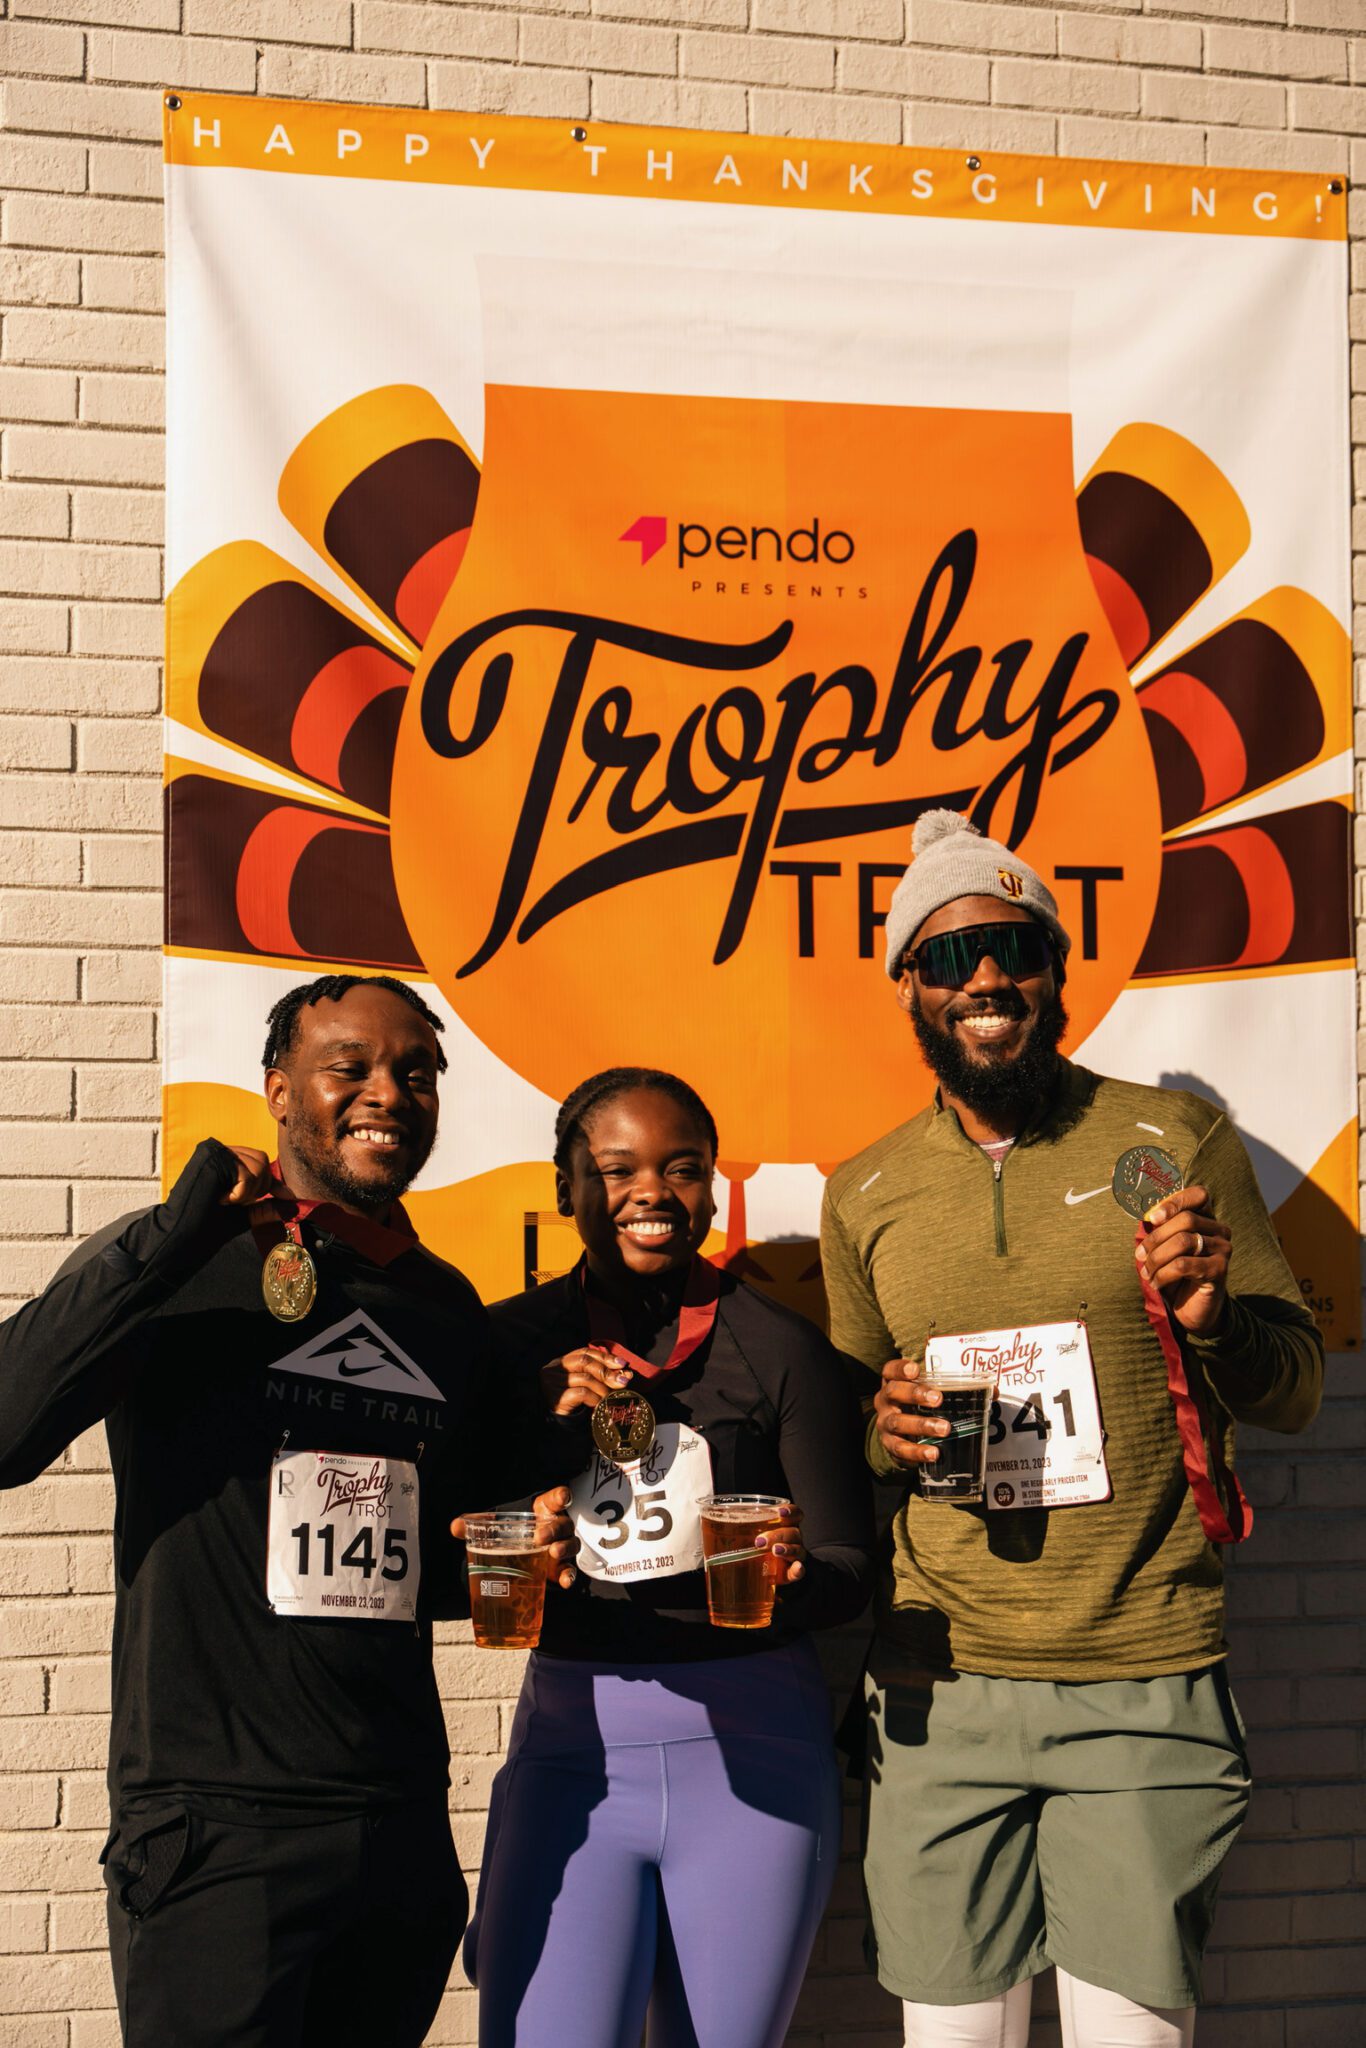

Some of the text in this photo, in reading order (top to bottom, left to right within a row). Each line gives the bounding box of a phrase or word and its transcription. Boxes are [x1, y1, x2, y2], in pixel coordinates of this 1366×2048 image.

[193, 116, 1324, 223] HAPPY THANKSGIVING!
[678, 517, 855, 568] pendo
[692, 580, 867, 599] PRESENTS
[420, 527, 1121, 980] Trophy
[770, 860, 1125, 960] TRT
[961, 1331, 1042, 1387] Trophy
[1003, 1369, 1045, 1386] TROT
[266, 1380, 443, 1430] NIKE TRAIL
[325, 1456, 347, 1465] pendo
[987, 1457, 1051, 1472] NOVEMBER 23, 2023
[317, 1460, 393, 1517] Trophy
[1057, 1475, 1075, 1485] PRICED
[1076, 1474, 1088, 1483] ITEM
[356, 1503, 393, 1518] TROT
[998, 1495, 1011, 1503] OFF
[594, 1490, 673, 1550] 35
[291, 1522, 408, 1582] 1145
[605, 1555, 674, 1576] NOVEMBER 23, 2023
[321, 1594, 357, 1608] NOVEMBER
[358, 1597, 369, 1610] 23,
[370, 1597, 385, 1609] 2023
